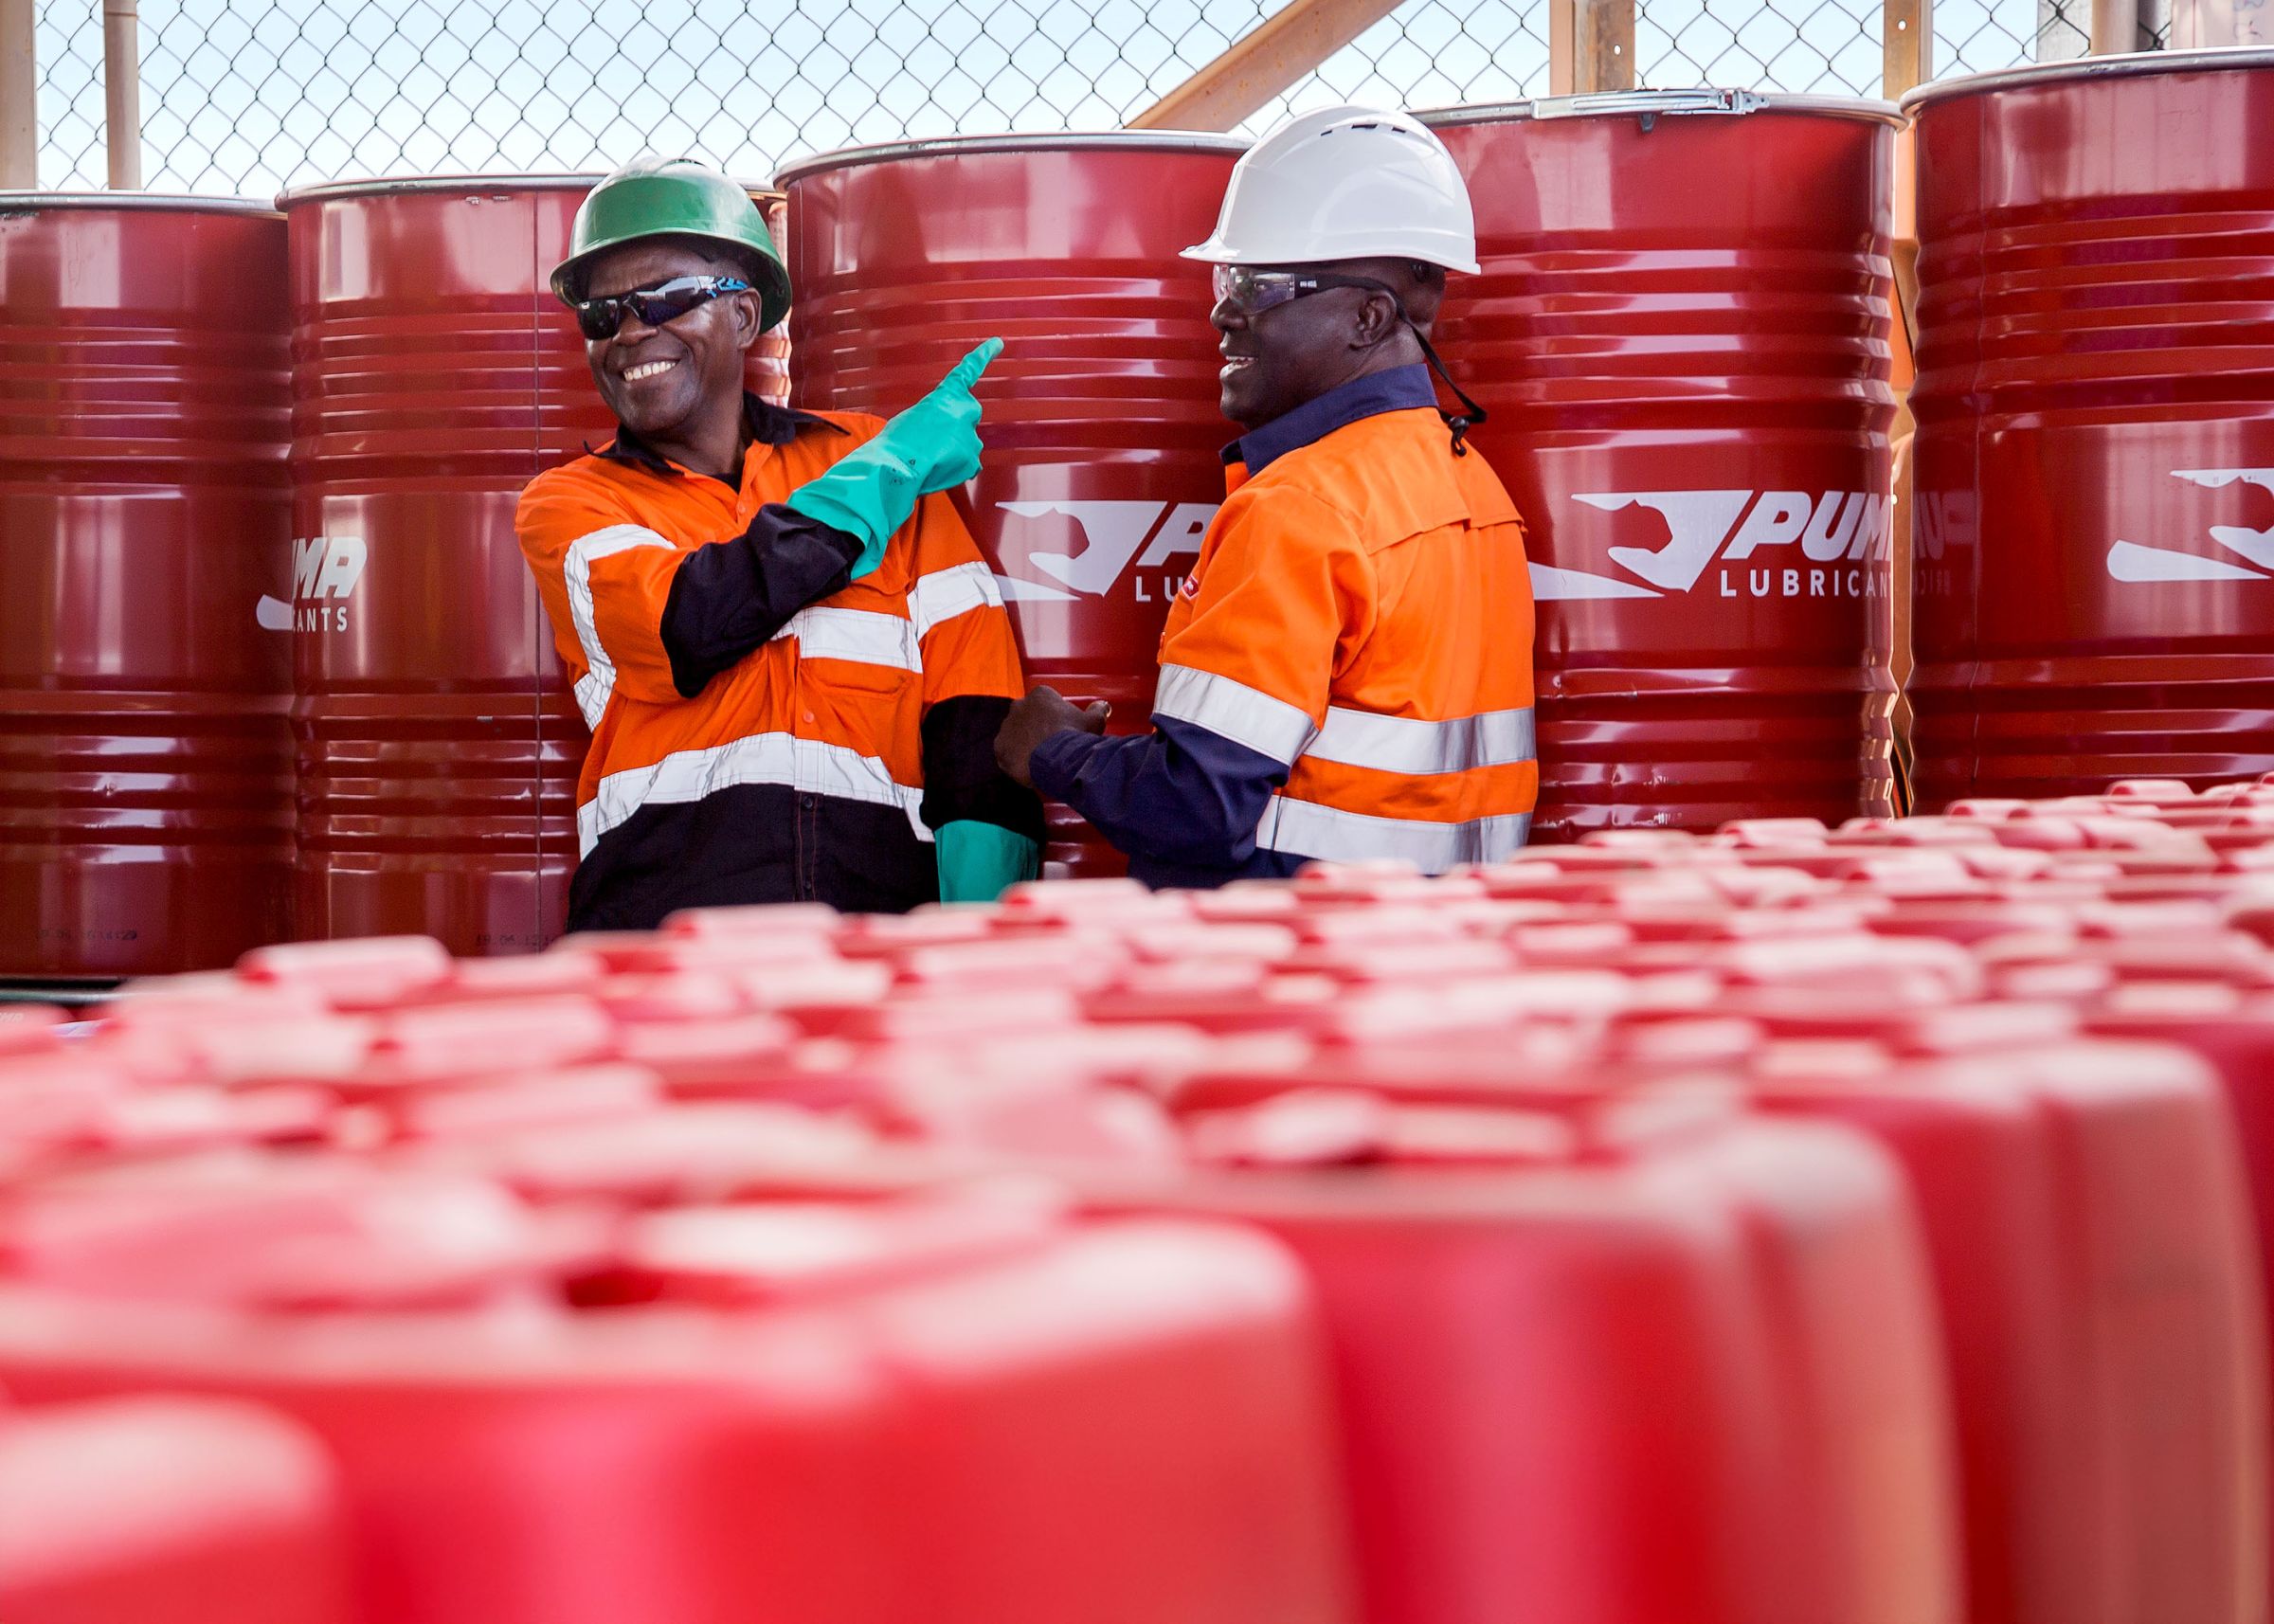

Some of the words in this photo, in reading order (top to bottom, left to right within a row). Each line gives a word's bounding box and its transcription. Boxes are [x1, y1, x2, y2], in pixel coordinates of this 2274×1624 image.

[1721, 490, 1892, 562] PUM
[292, 536, 368, 599] MA
[1721, 569, 1892, 598] LUBRICAN
[293, 606, 348, 632] ANTS
